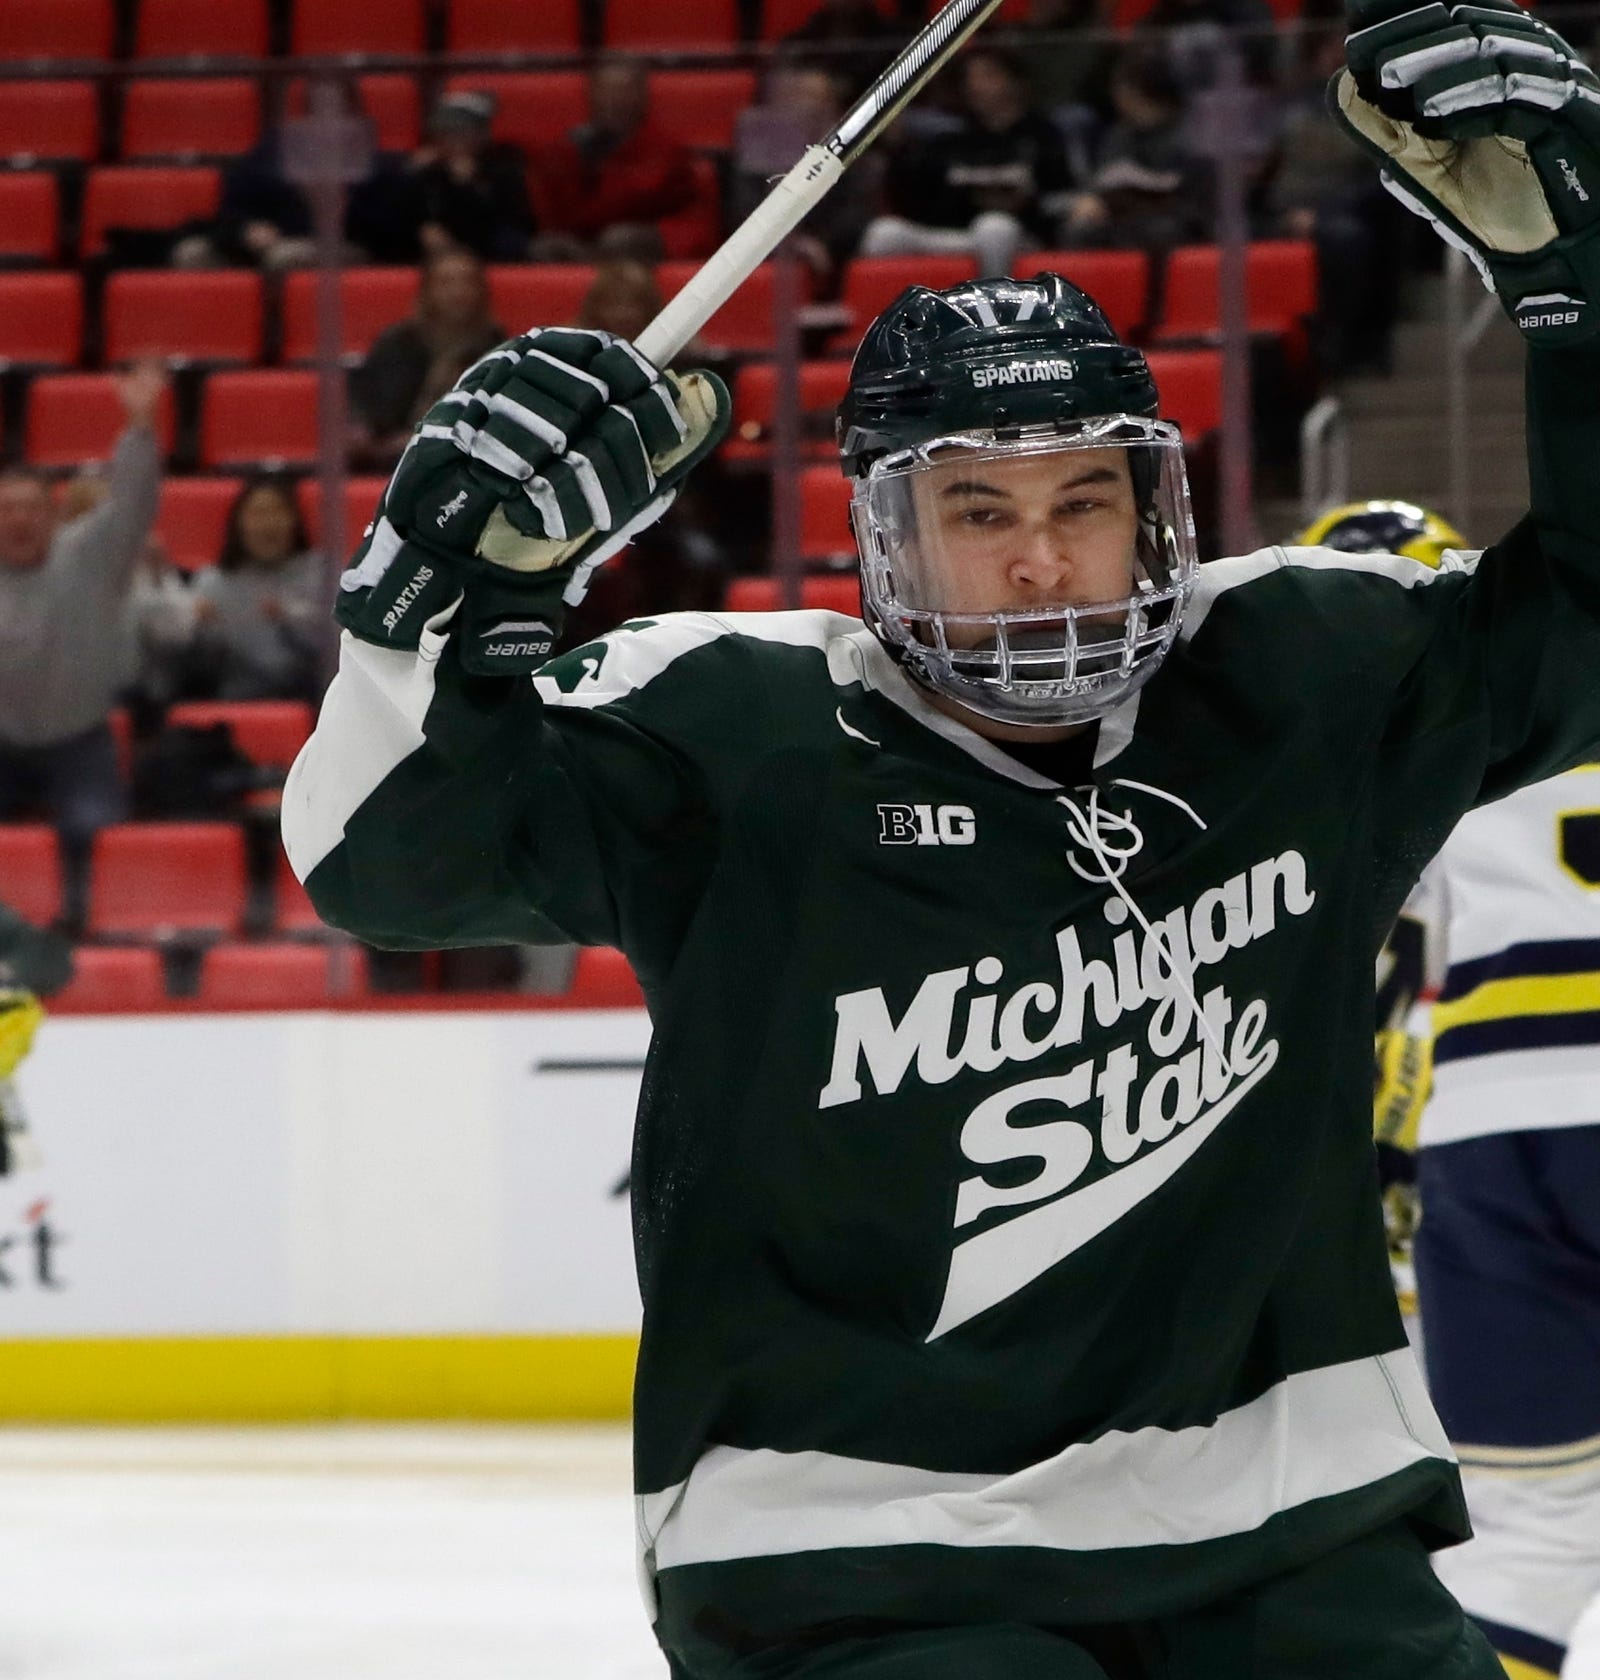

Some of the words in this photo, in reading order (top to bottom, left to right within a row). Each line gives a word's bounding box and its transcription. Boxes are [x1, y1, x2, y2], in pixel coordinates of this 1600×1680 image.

[973, 287, 1041, 328] 17
[971, 360, 1074, 389] SPARTANS
[382, 564, 435, 637] SPARTANS
[818, 849, 1316, 1109] Michigan
[953, 984, 1280, 1229] State
